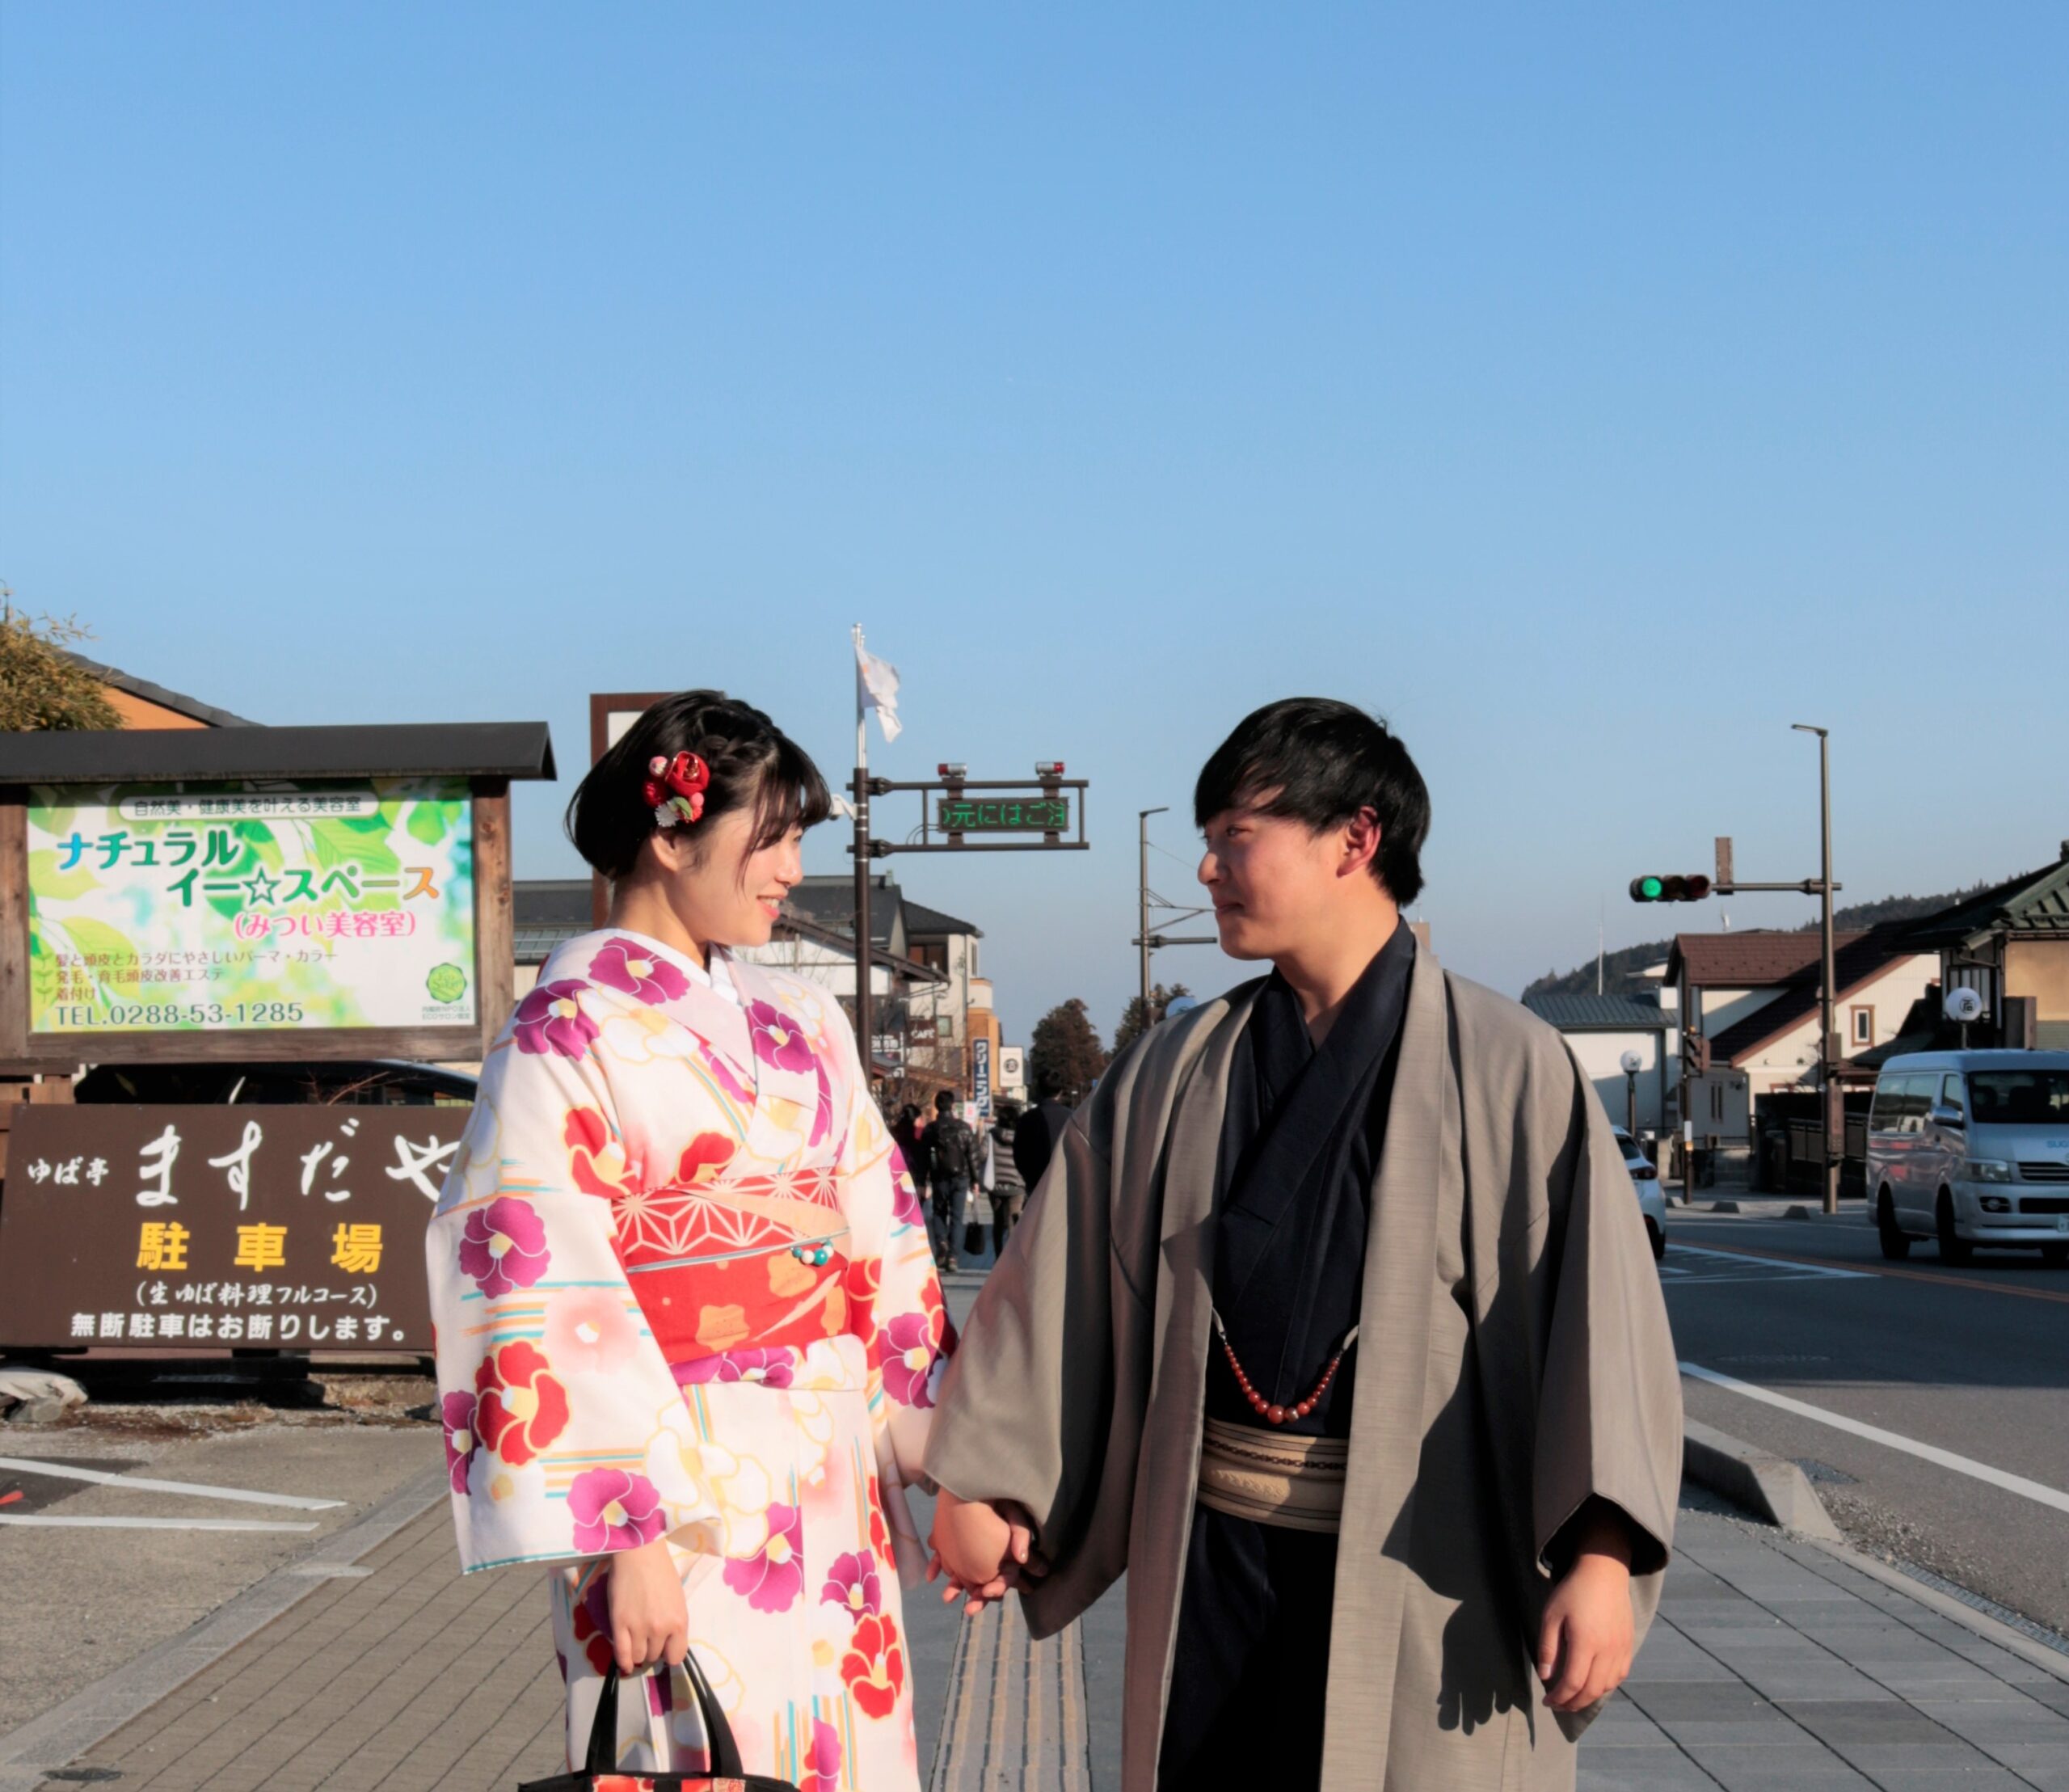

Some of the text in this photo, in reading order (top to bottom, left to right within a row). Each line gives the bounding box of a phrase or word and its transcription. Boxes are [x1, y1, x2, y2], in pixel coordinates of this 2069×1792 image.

[134, 795, 361, 816] 自然美・健康美を叶える美容室
[57, 829, 240, 870] ナチュラル
[234, 911, 416, 938] (みつい美容室)
[56, 1002, 304, 1026] TEL.0288-53-1285
[136, 1118, 461, 1210] ますだや
[136, 1222, 384, 1274] 駐車場
[71, 1313, 405, 1342] 無断駐車はお断りします。
